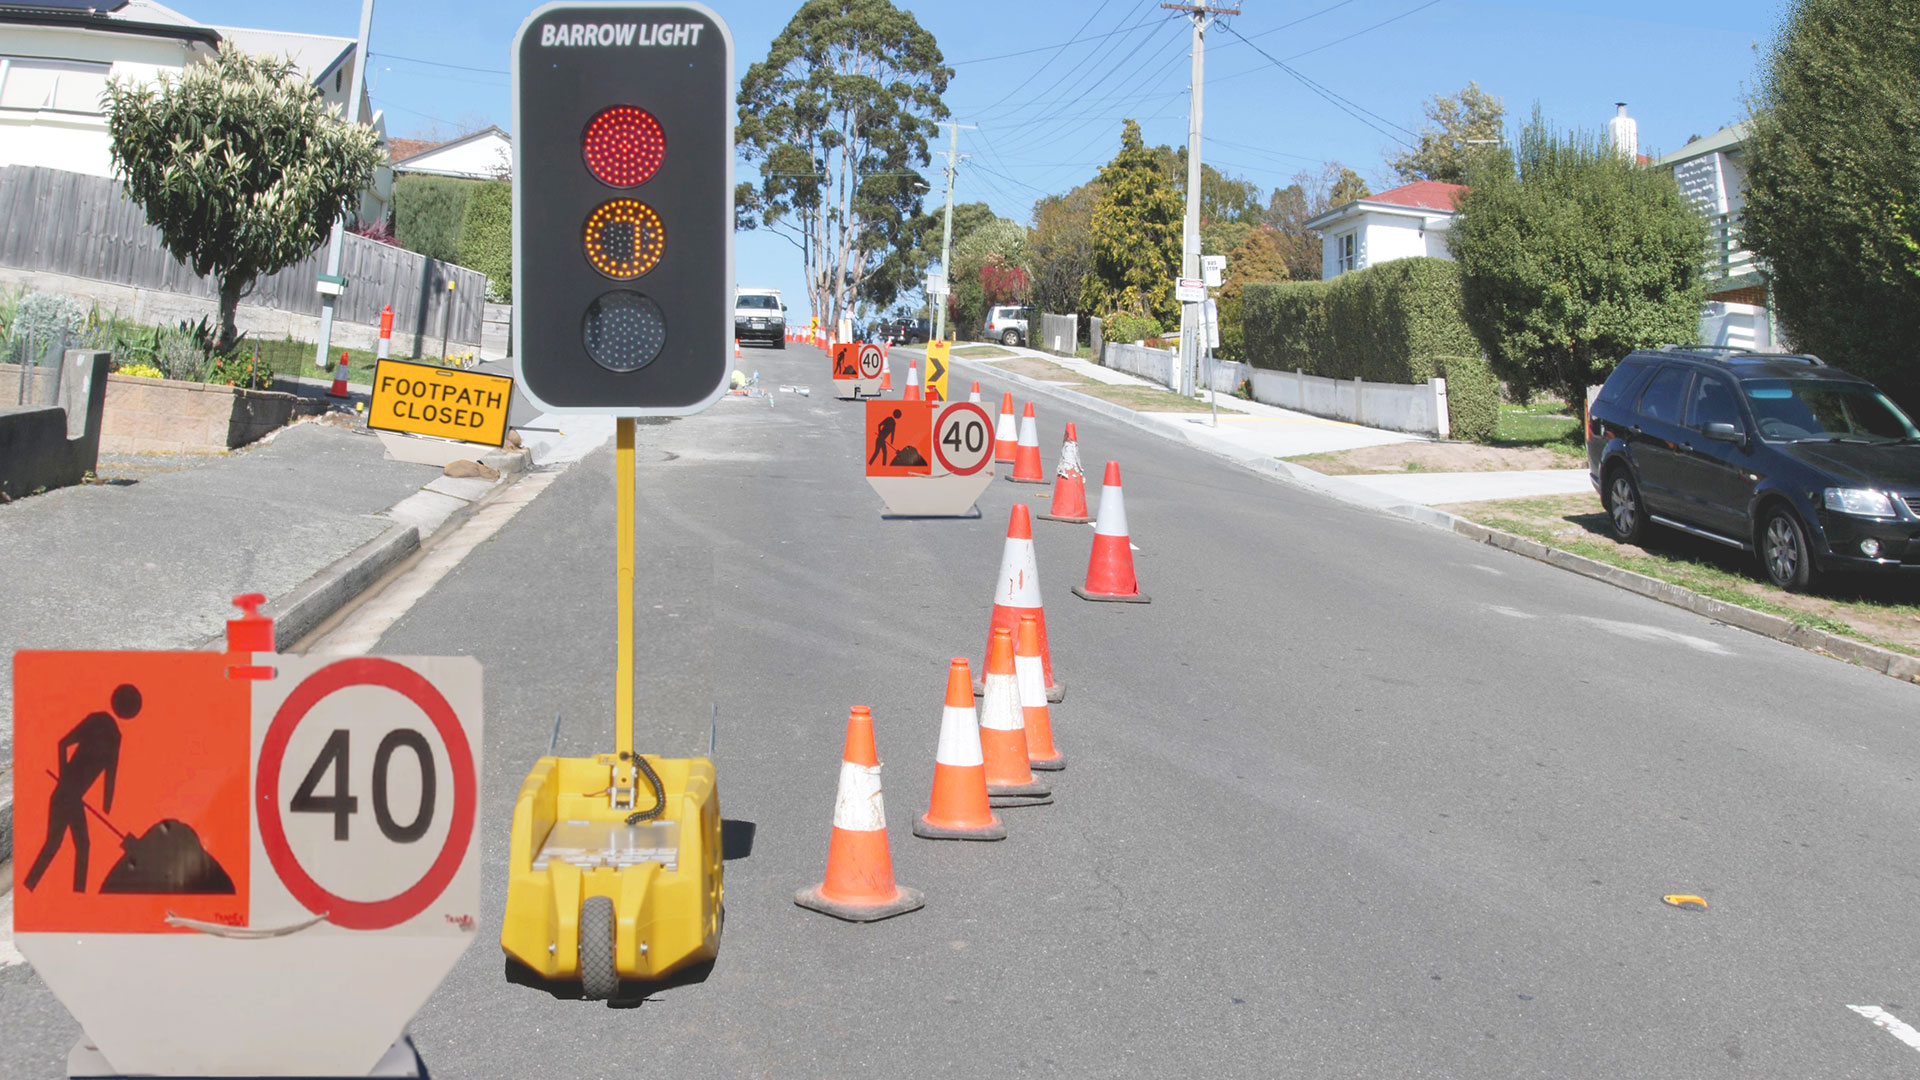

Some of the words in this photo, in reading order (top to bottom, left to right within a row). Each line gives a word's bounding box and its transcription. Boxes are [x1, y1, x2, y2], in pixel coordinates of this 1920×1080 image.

[541, 24, 637, 46] BARROW
[638, 24, 704, 46] LIGHT
[862, 353, 880, 368] 40
[381, 376, 502, 409] FOOTPATH
[393, 400, 484, 428] CLOSED
[942, 421, 984, 453] 40
[290, 728, 437, 844] 40
